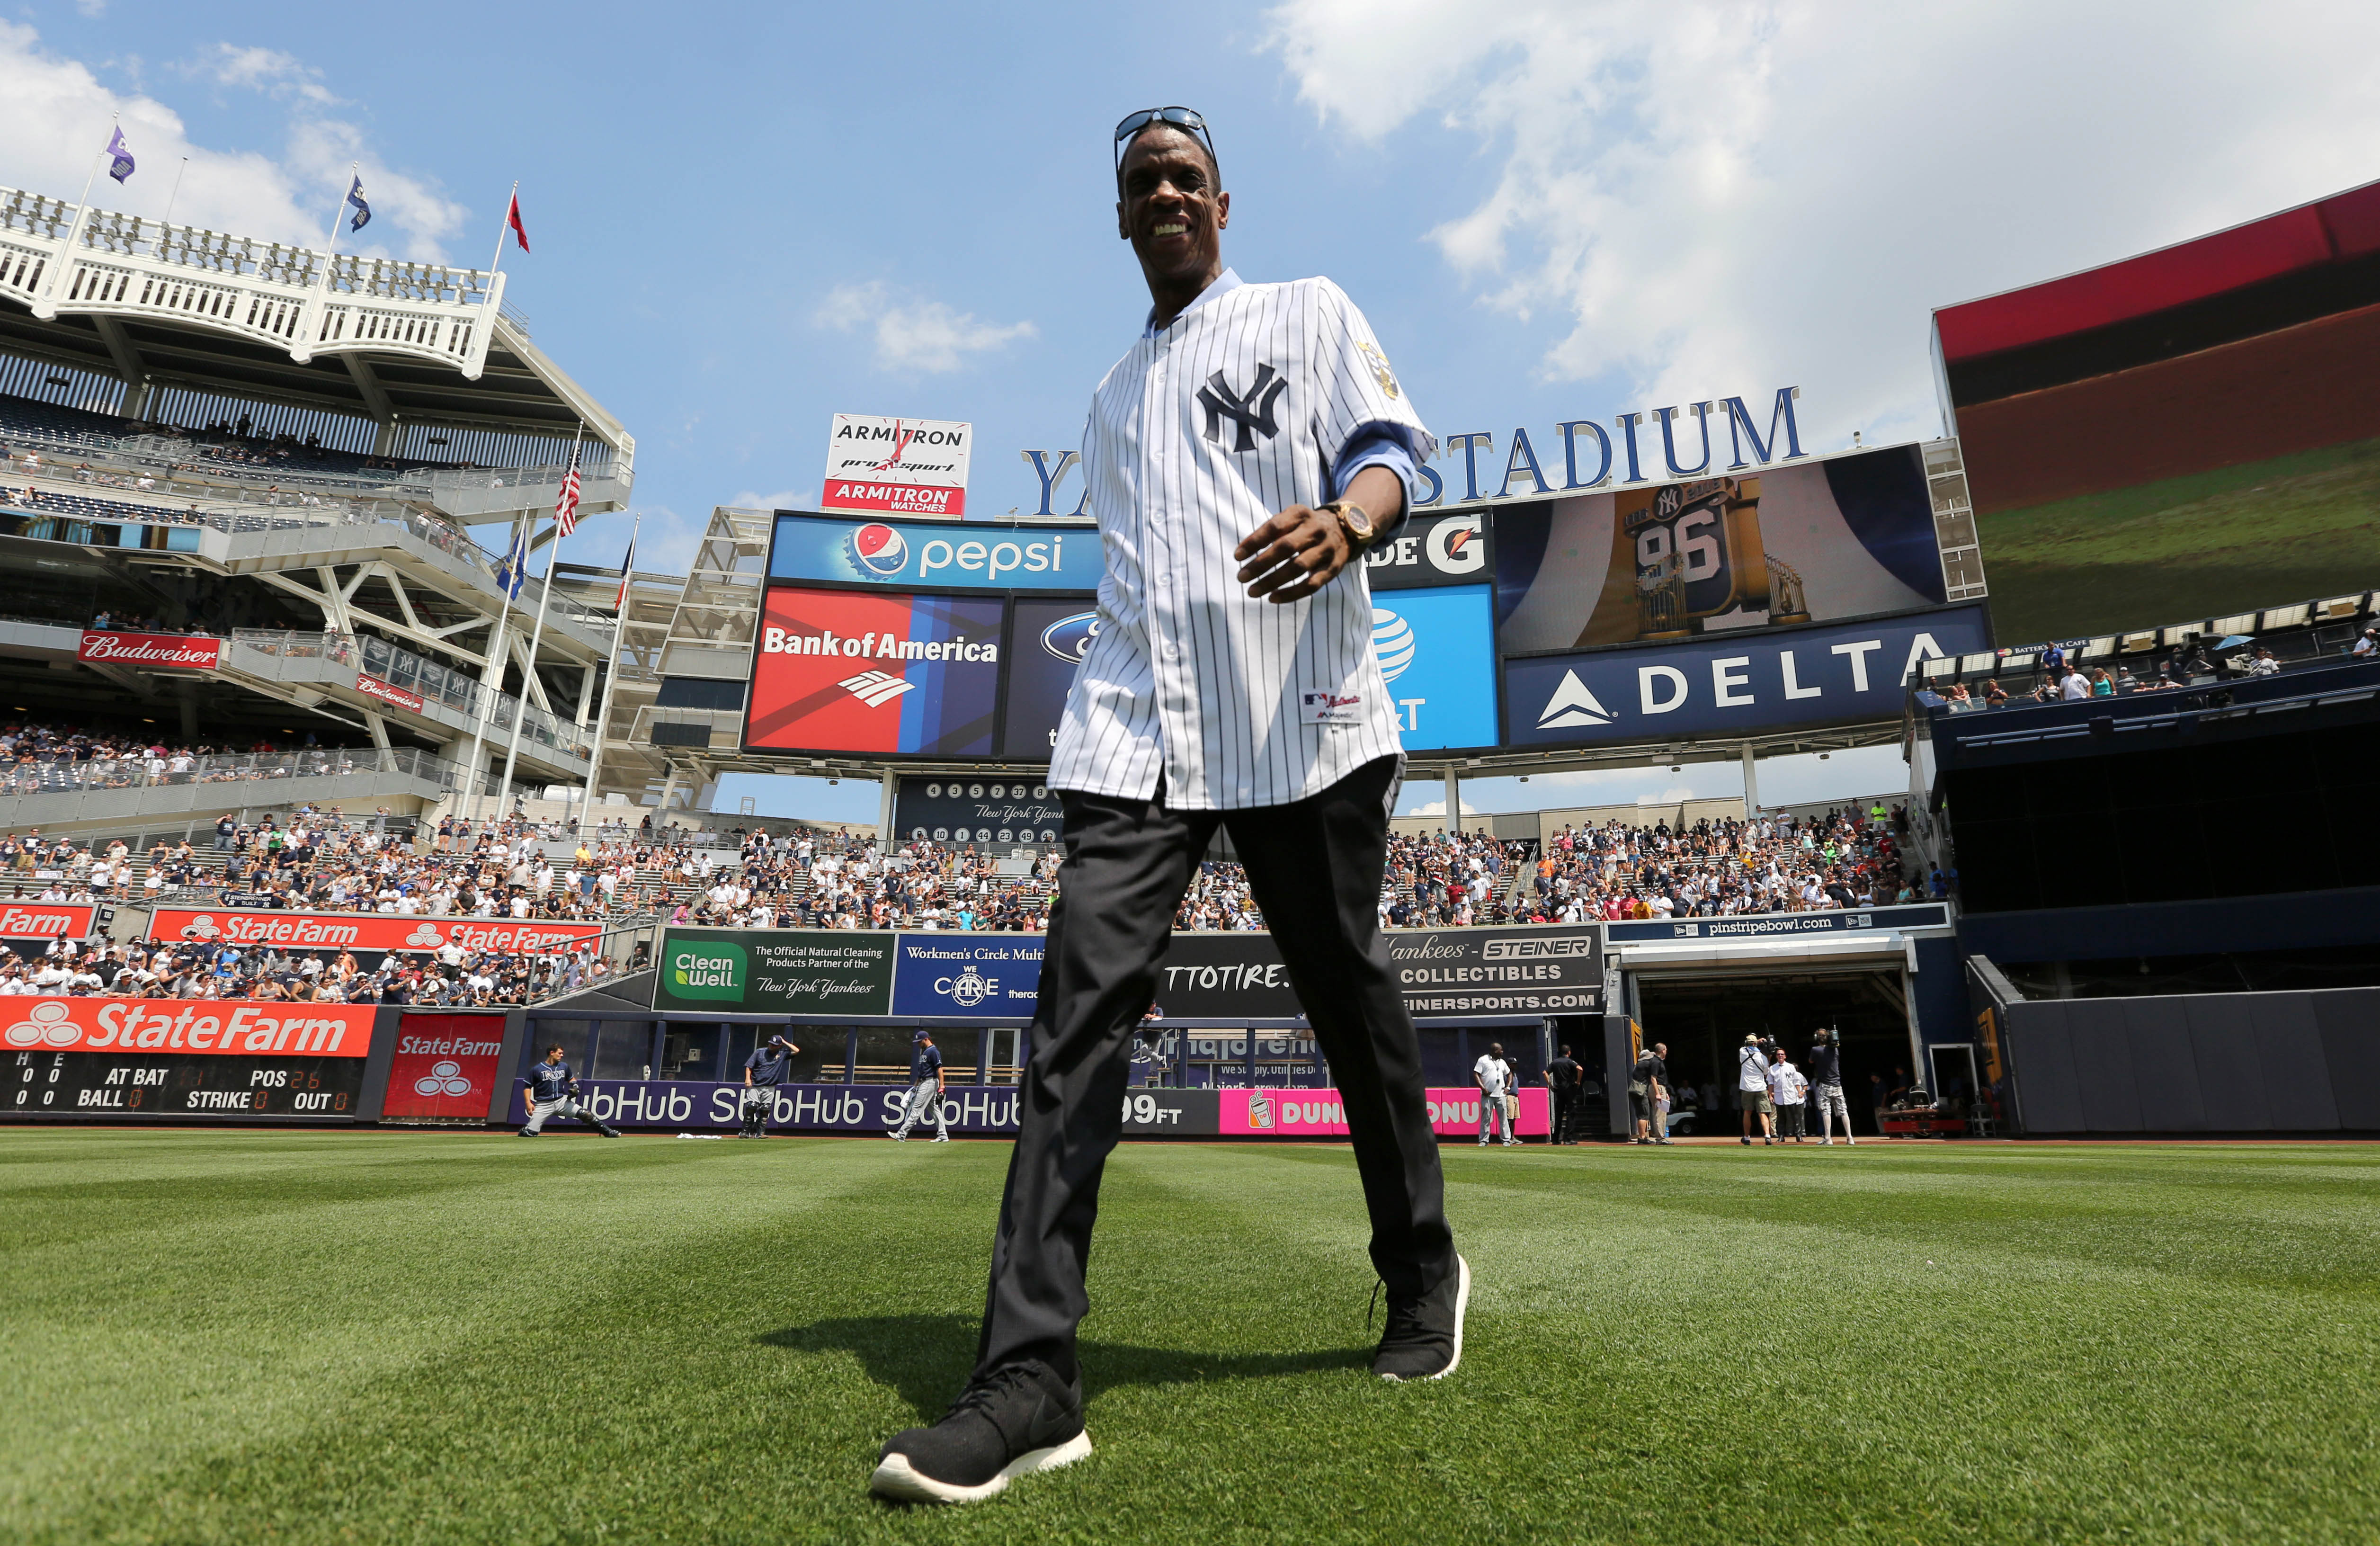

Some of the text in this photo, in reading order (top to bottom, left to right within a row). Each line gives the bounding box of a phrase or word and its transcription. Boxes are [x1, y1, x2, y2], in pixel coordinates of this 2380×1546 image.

[838, 424, 962, 447] ARMITRON
[1413, 386, 1809, 507] STADIUM
[834, 484, 949, 504] ARMITRON
[890, 500, 946, 513] WATCHES
[1637, 509, 1720, 583] 96
[919, 535, 1062, 580] pepsi
[82, 635, 217, 663] Budweiser
[764, 627, 998, 663] Bank of America
[1638, 632, 1945, 715] DELTA
[357, 677, 421, 709] Budweiser
[974, 804, 1002, 818] New
[1002, 805, 1032, 824] York
[1709, 917, 1832, 936] pinstripebowl.com
[756, 947, 882, 959] The Official Natural Cleaning
[906, 947, 971, 960] Workmen's
[974, 948, 1009, 960] Circle
[1486, 940, 1587, 957] STEINER
[676, 954, 733, 971] Clean
[767, 958, 869, 968] Products Partner of the
[688, 970, 732, 986] Well
[1400, 965, 1562, 983] COLLECTIBLES
[757, 978, 871, 999] New York Yankees
[16, 1053, 64, 1066] H E
[23, 1068, 33, 1082] 0
[49, 1069, 59, 1082] 0
[105, 1069, 130, 1085] AT
[133, 1069, 168, 1085] BAT
[250, 1070, 287, 1087] POS
[17, 1090, 27, 1105] 0
[44, 1091, 53, 1105] 0
[77, 1090, 123, 1107] BALL
[187, 1091, 251, 1108] STRIKE
[294, 1093, 331, 1109] OUT
[709, 1088, 864, 1124] StbHub
[1282, 1102, 1348, 1124] DUN
